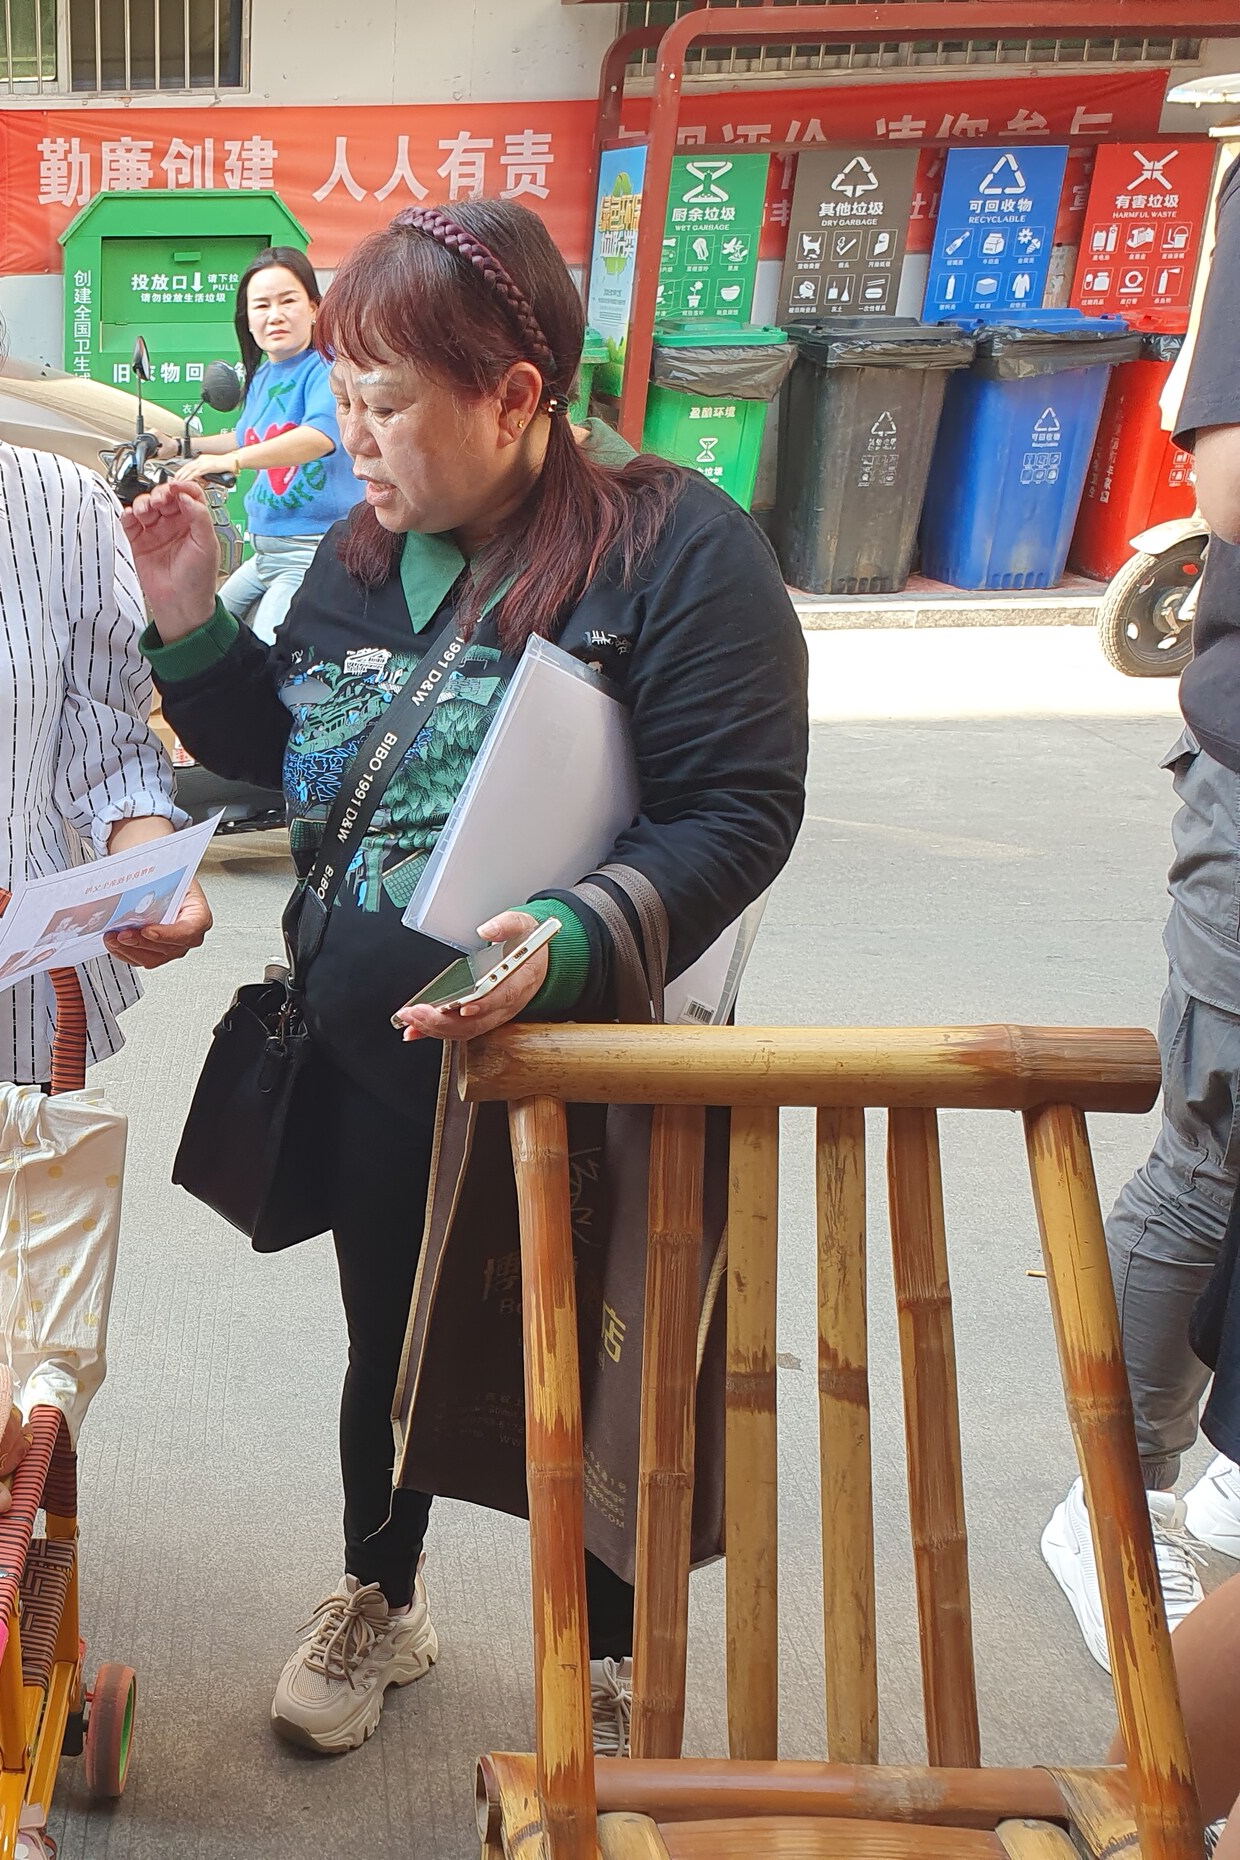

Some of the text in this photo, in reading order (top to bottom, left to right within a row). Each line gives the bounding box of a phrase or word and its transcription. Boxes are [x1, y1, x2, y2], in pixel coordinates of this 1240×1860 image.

[37, 135, 279, 207] 勤廉创建
[312, 129, 555, 203] 人人有责
[818, 201, 884, 217] 其他垃圾
[968, 198, 1033, 213] 可回收物
[1115, 194, 1179, 209] 有害垃圾
[671, 206, 736, 222] 厨余垃圾
[968, 215, 1027, 224] RECYCLABLE
[1112, 210, 1177, 219] HARMFUL WASTE
[821, 218, 878, 227] DRY GARBAGE
[131, 273, 188, 291] 投放口
[207, 273, 239, 283] 请下拉
[141, 293, 227, 303] 请勿投放生活垃圾
[73, 269, 92, 380] 创建全国卫生
[411, 636, 466, 707] 1991 D&W
[336, 731, 398, 844] BIBO 1991 D&W
